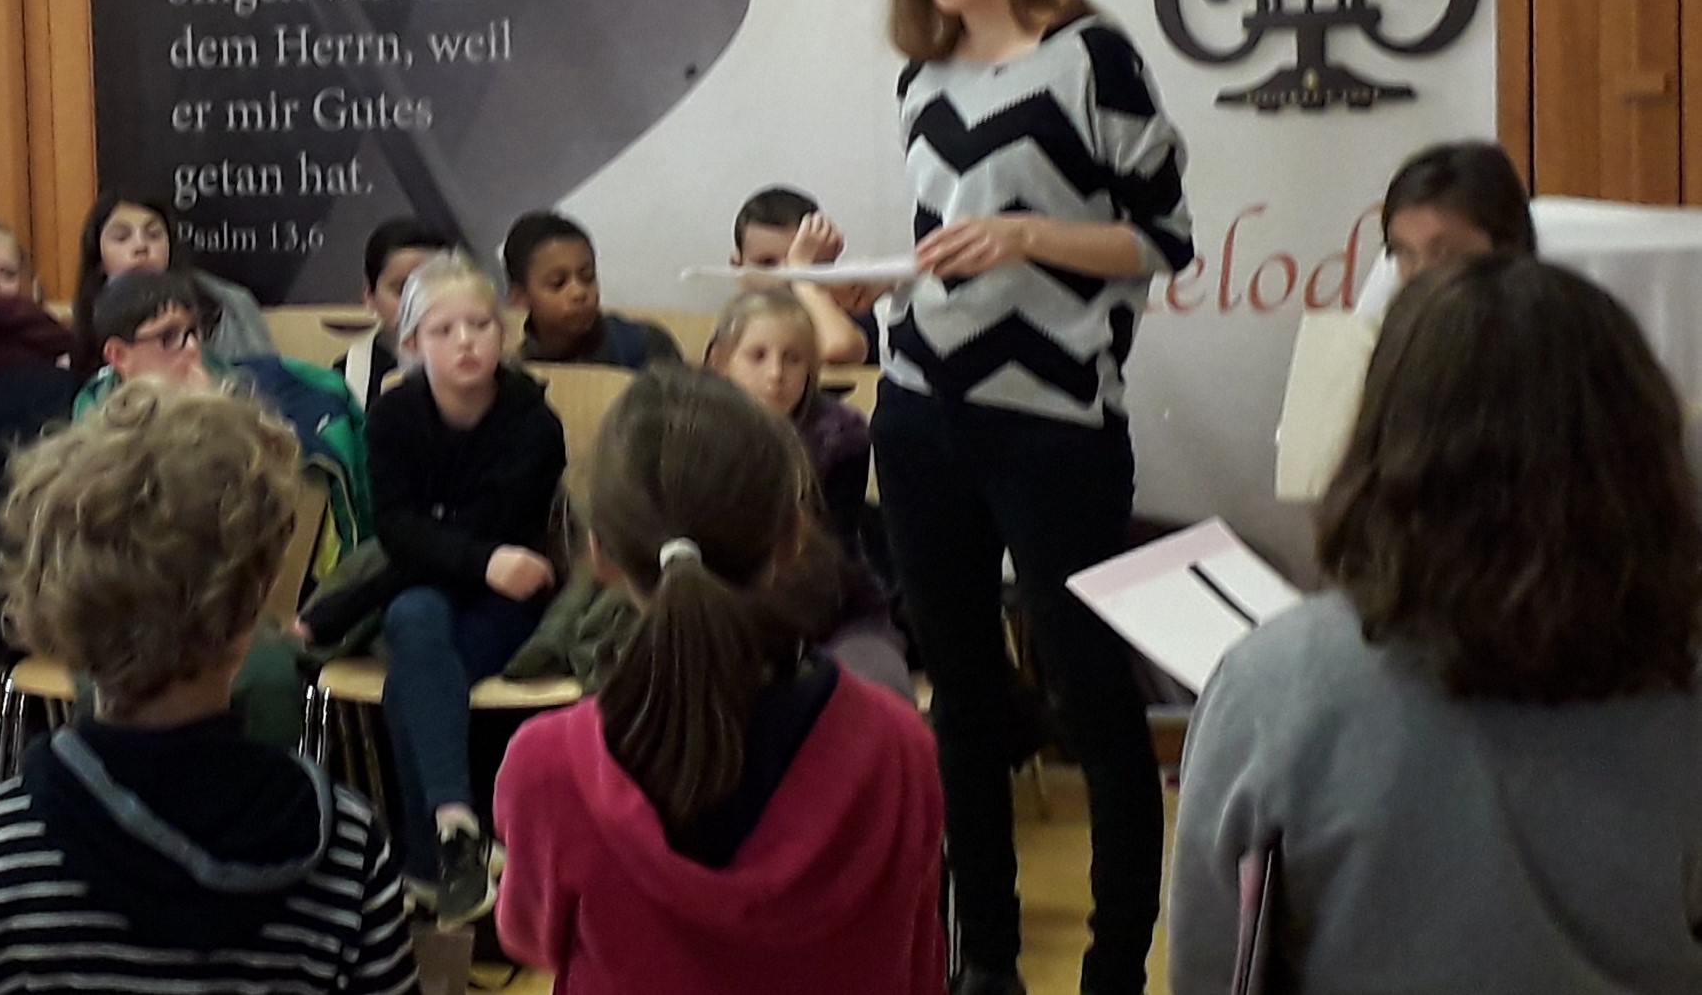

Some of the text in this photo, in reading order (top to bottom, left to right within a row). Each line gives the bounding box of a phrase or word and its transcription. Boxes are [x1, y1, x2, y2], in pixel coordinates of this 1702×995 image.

[170, 18, 511, 70] dem Herrn, weil
[171, 86, 433, 133] er mir Gutes
[175, 151, 374, 209] getan hat.
[176, 221, 325, 254] Psalm 13,6
[1140, 202, 1384, 314] elod
